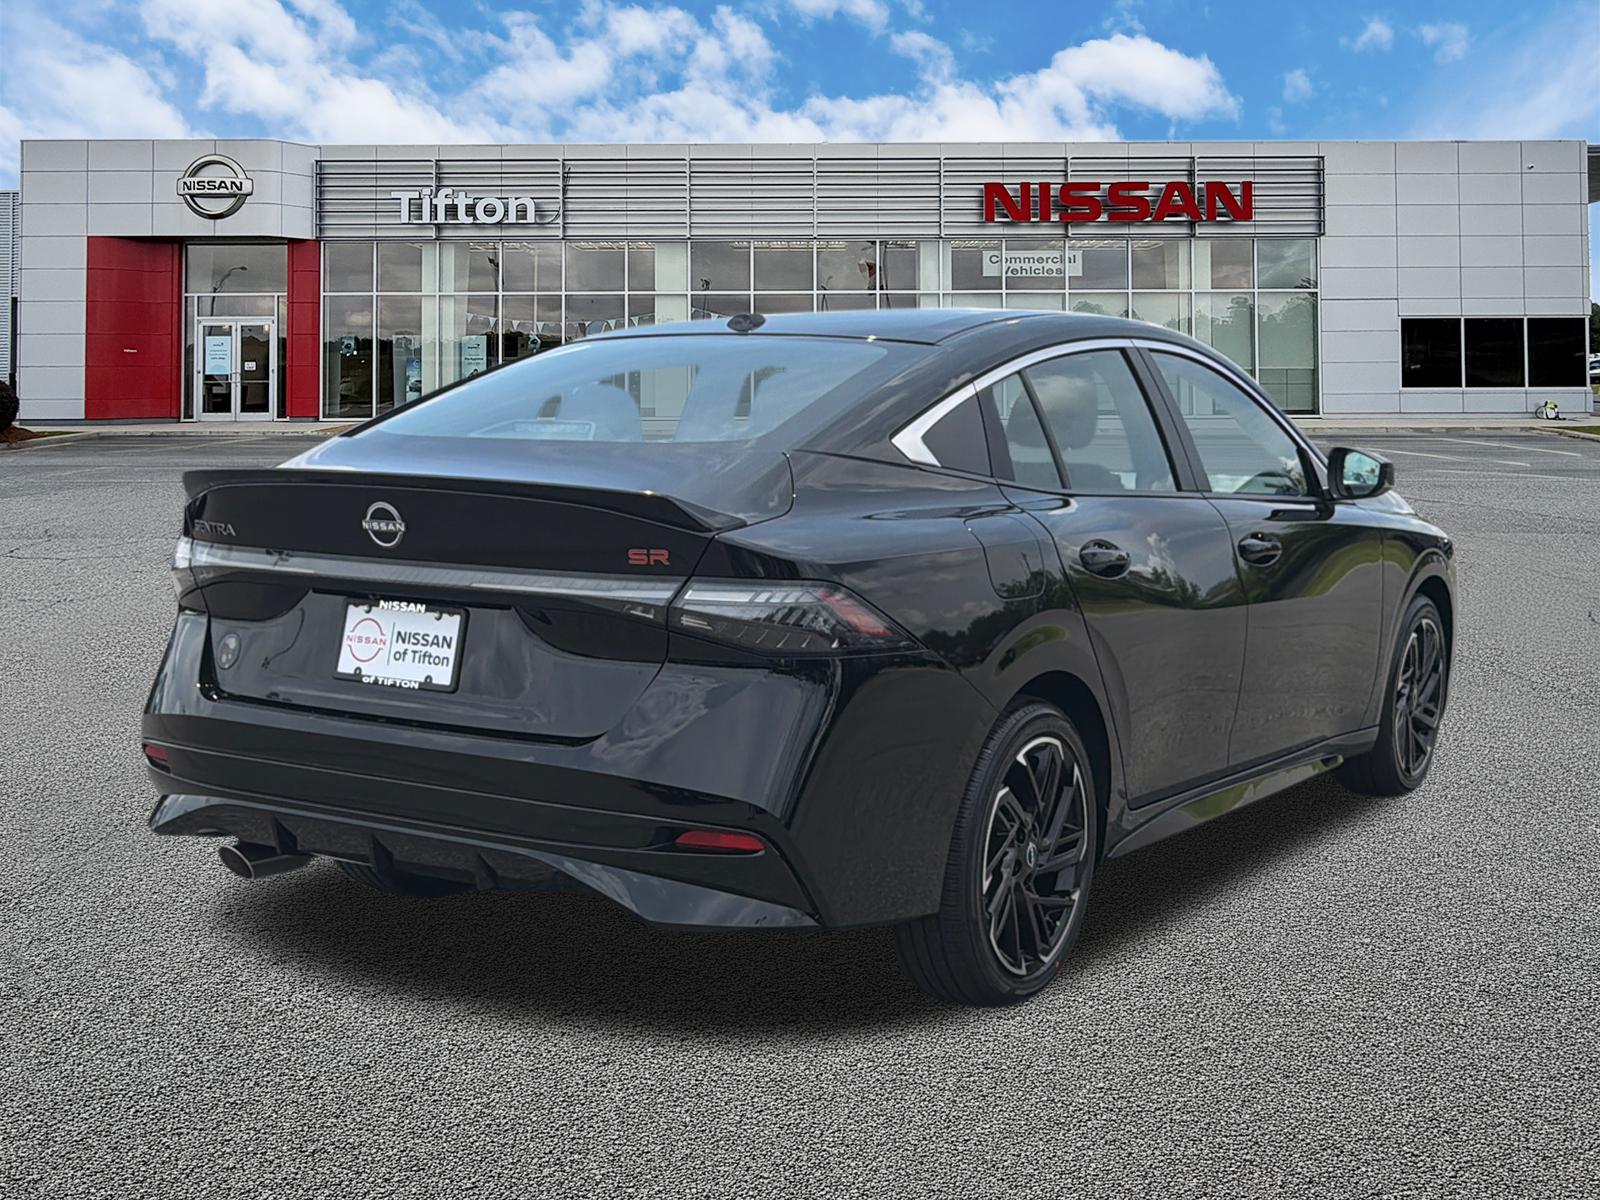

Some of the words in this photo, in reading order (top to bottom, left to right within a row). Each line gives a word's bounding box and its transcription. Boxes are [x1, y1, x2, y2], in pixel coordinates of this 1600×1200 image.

[183, 180, 243, 191] NISSAN
[391, 188, 536, 224] Tifton
[984, 181, 1253, 222] NISSAN
[362, 520, 406, 532] NISSAN
[627, 548, 670, 566] SR
[378, 600, 427, 613] NISSAN
[345, 634, 388, 647] NISSAN
[395, 630, 453, 650] NISSAN
[393, 648, 408, 662] of
[411, 649, 450, 667] Tifton
[361, 676, 375, 684] of
[377, 676, 420, 689] TIFTON
